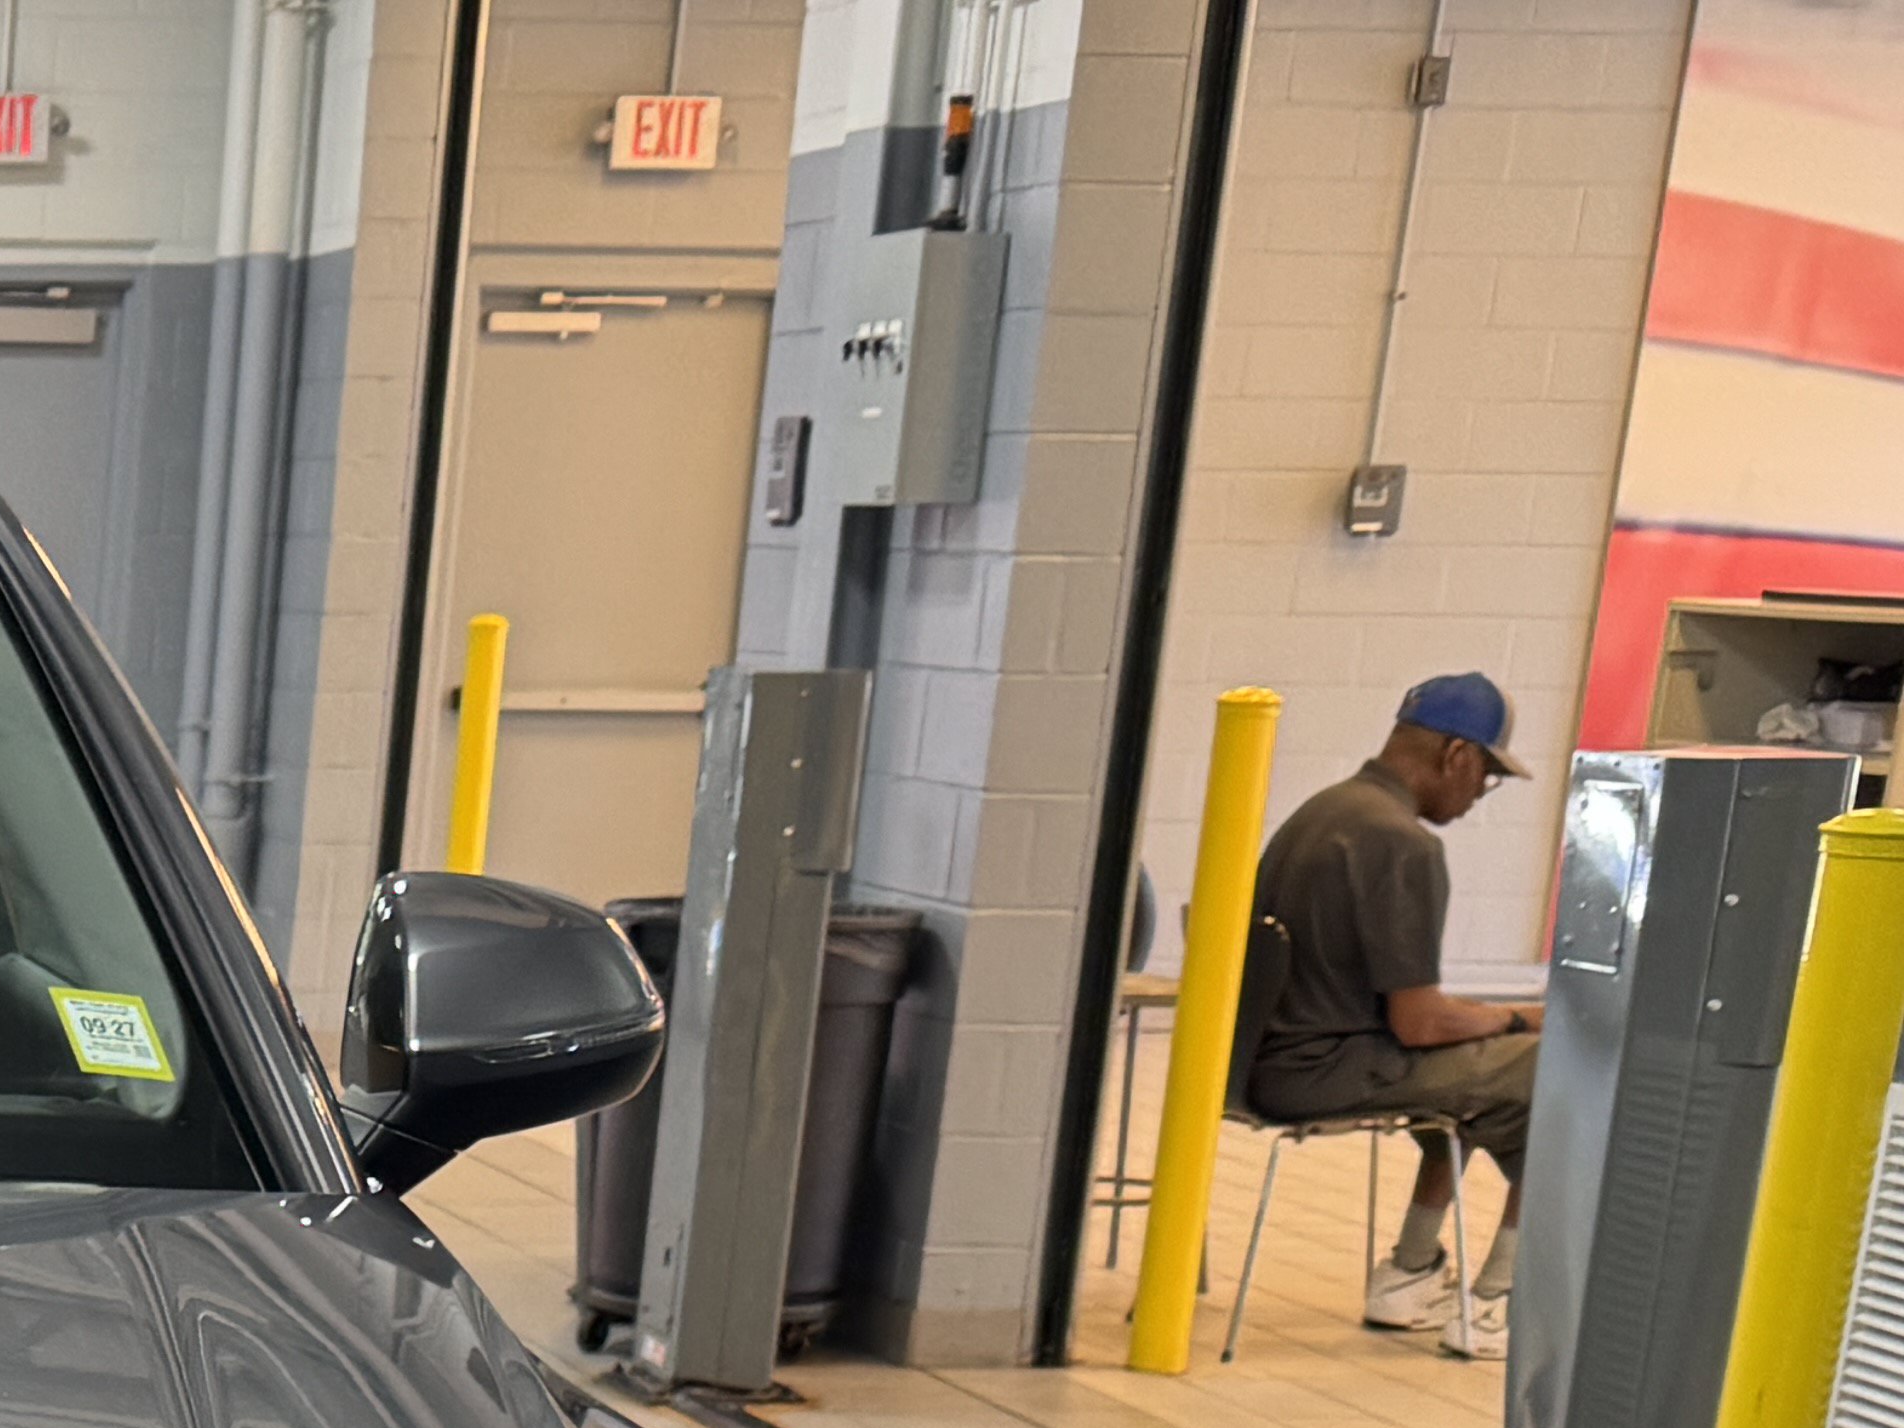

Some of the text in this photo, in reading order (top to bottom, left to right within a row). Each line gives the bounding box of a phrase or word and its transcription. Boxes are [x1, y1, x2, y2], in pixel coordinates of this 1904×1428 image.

[633, 100, 708, 157] EXIT
[80, 1016, 135, 1036] 09 27
